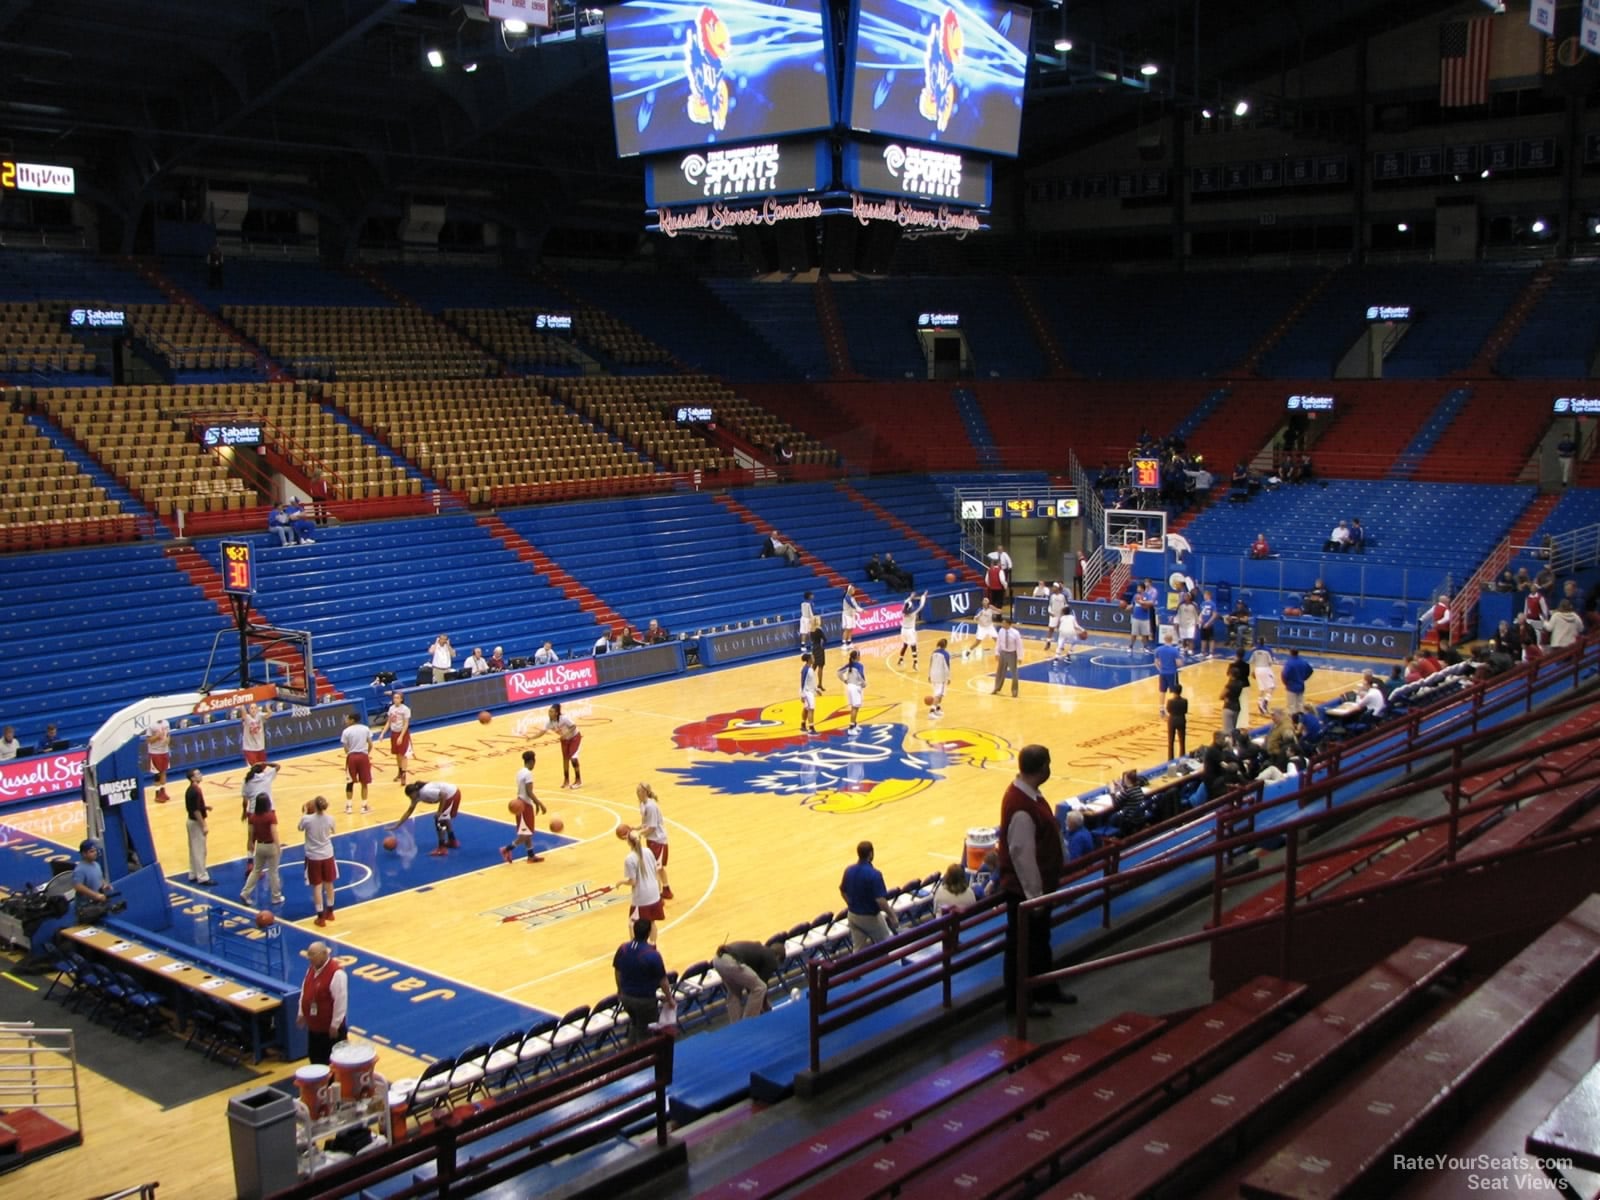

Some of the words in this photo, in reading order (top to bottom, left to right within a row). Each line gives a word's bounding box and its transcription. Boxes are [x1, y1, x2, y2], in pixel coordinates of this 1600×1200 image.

[705, 153, 780, 184] SPORTS
[903, 156, 962, 186] SPORTS
[703, 176, 777, 196] CHANNEL
[657, 204, 712, 237] Russell
[711, 201, 762, 230] Stover
[763, 196, 822, 225] Candies
[850, 192, 897, 226] Russell
[897, 200, 938, 227] Stover
[938, 204, 980, 231] Candies
[87, 309, 125, 320] Sabates
[1570, 398, 1600, 406] Sabat
[221, 427, 260, 437] Sabates
[1139, 469, 1156, 485] 30
[226, 545, 248, 560] 46:27
[229, 562, 247, 587] 30
[949, 592, 970, 614] KU
[1029, 605, 1101, 621] BERE
[1275, 626, 1317, 639] THE
[1330, 631, 1396, 648] PHOG
[509, 668, 558, 695] Russell
[556, 665, 593, 685] Stover
[539, 680, 590, 695] CANDIES
[133, 714, 151, 730] KU
[0, 761, 52, 796] ussell
[26, 779, 82, 796] CANDI
[99, 777, 137, 797] MUSCLE
[108, 790, 133, 806] MILK
[267, 925, 281, 939] KU
